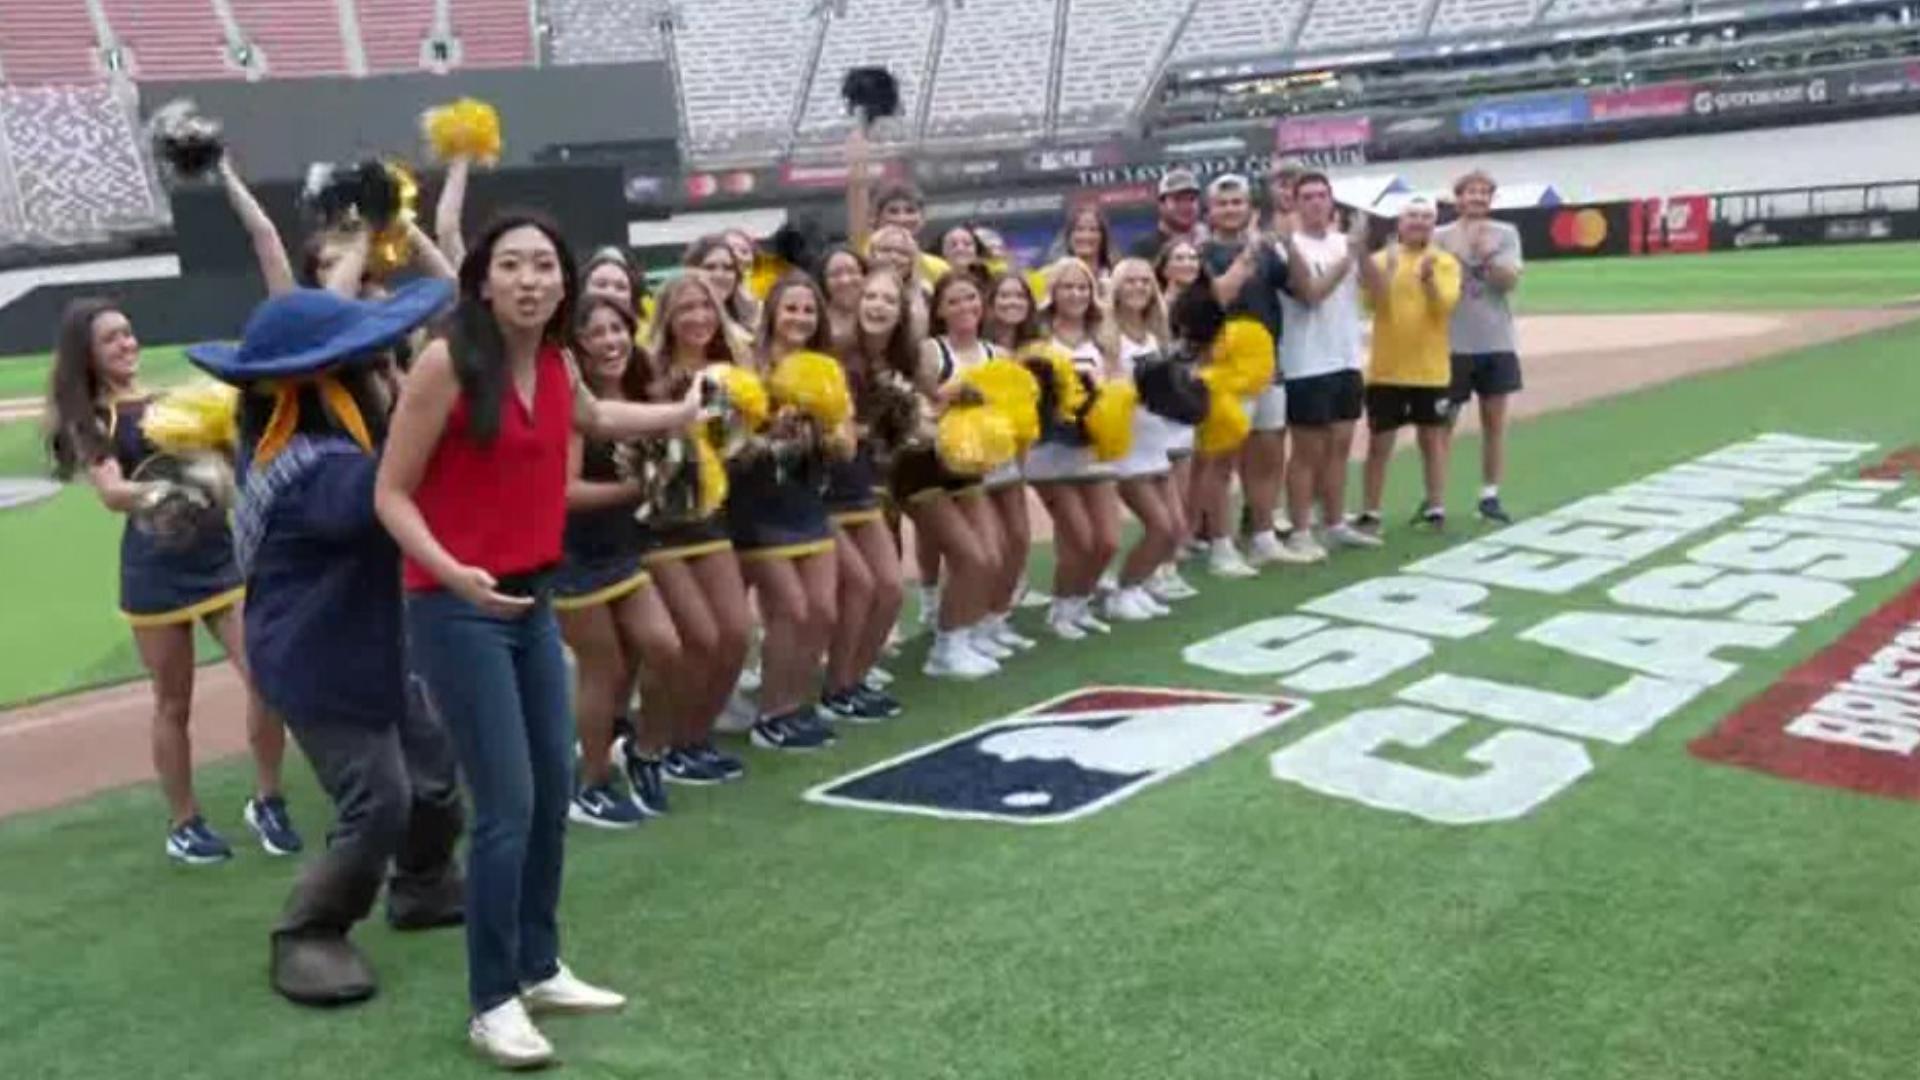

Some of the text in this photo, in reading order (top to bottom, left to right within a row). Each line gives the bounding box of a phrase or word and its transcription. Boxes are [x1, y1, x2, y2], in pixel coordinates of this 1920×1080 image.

[1183, 432, 1880, 692] SPEEDWAY
[1270, 488, 1920, 823] CLASSIC
[1783, 621, 1920, 756] BRIST
